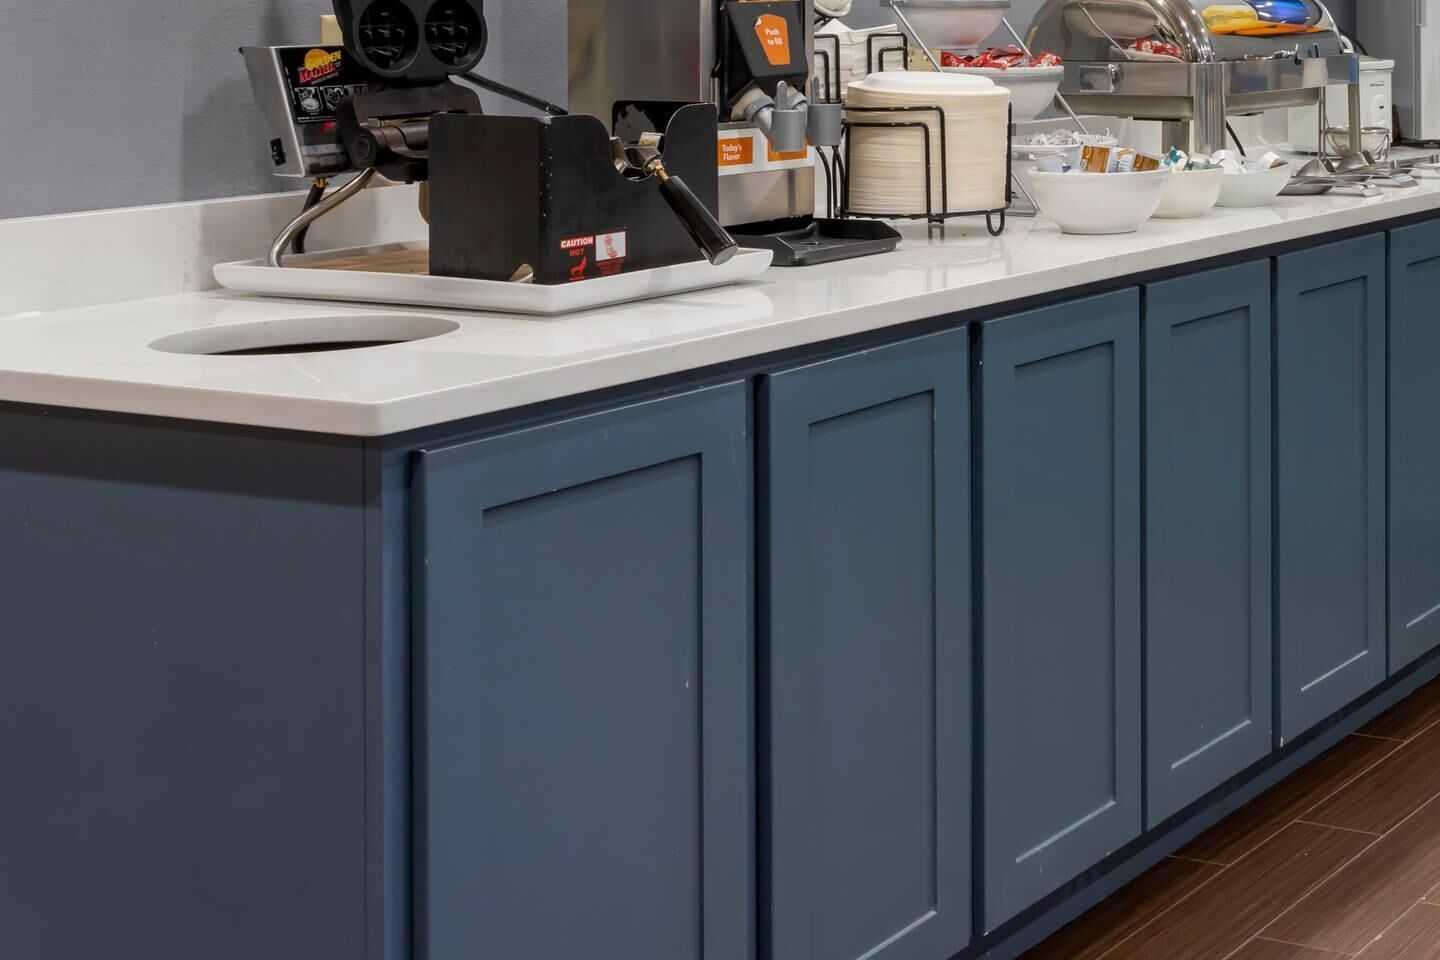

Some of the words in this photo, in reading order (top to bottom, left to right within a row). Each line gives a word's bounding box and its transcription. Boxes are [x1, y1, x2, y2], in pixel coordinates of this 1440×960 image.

[765, 27, 780, 35] Push
[767, 38, 775, 46] to
[775, 37, 783, 45] fill
[305, 50, 342, 70] GOLDEN
[299, 62, 337, 83] MALTED
[722, 143, 742, 153] Today's
[723, 152, 740, 161] Flavor
[561, 236, 594, 248] CAUTION
[569, 248, 585, 257] HOT
